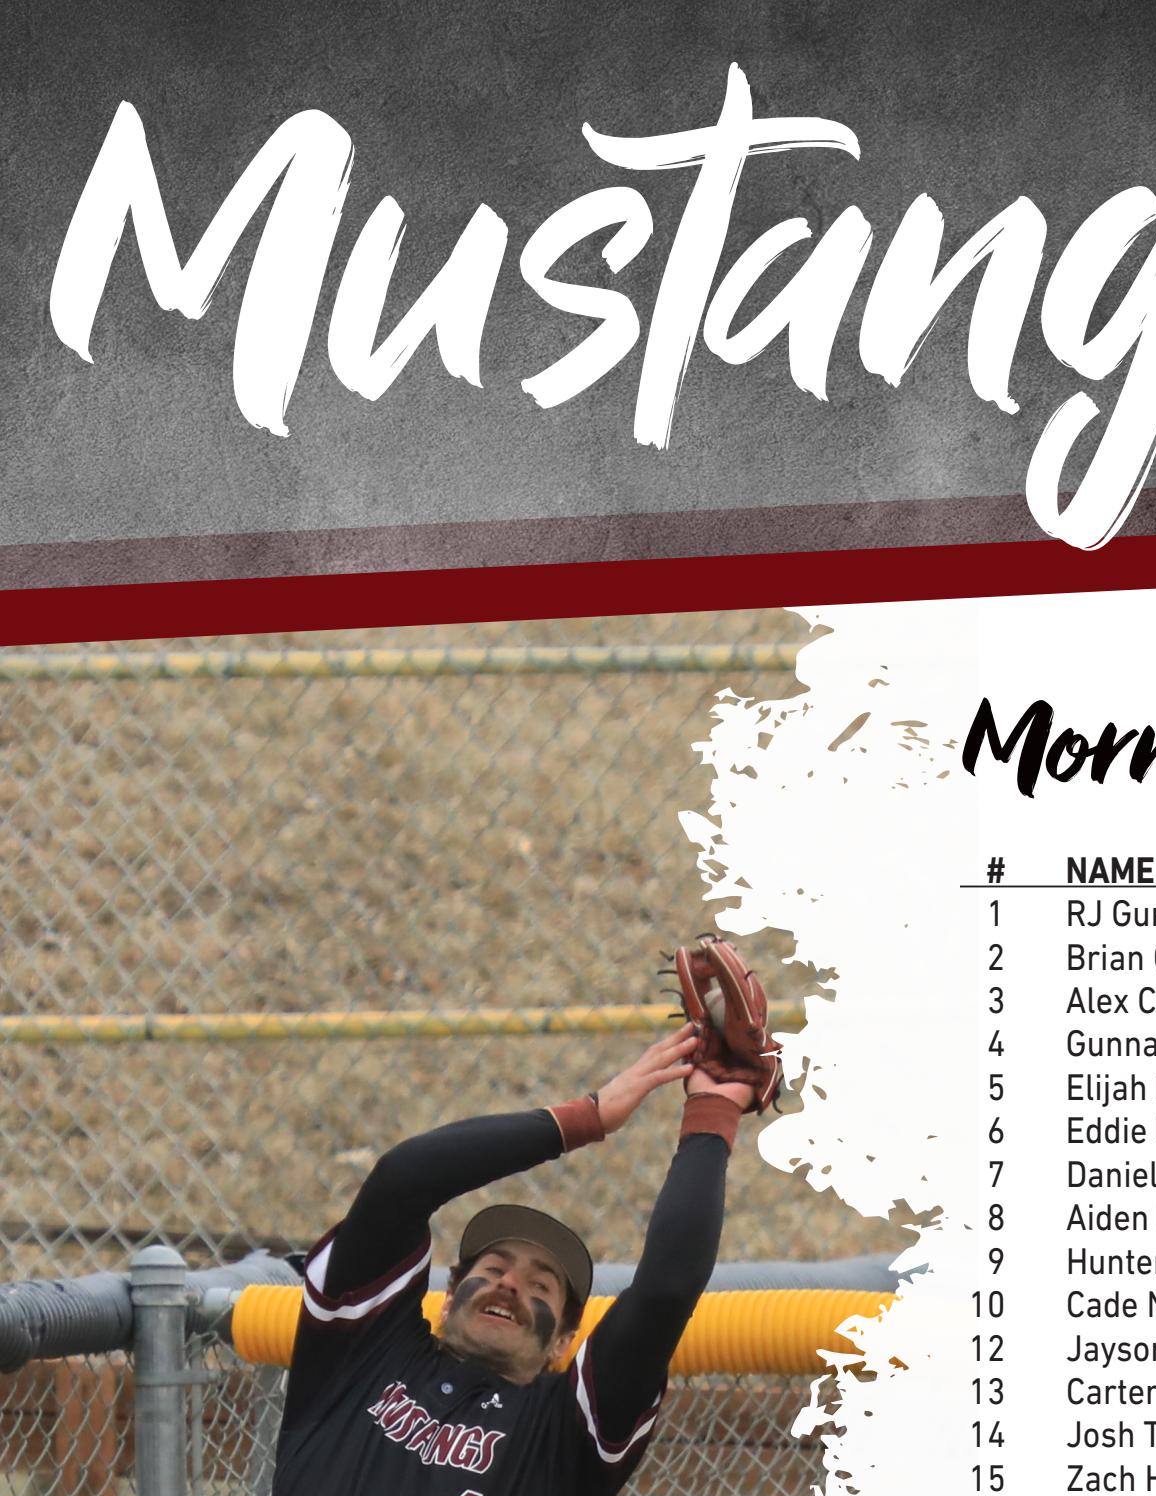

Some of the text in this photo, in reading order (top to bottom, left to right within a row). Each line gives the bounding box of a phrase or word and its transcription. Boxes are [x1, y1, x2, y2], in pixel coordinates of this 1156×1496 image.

[986, 856, 1006, 884] #
[1067, 856, 1154, 884] NAME
[990, 899, 999, 927] 1
[1067, 899, 1101, 927] RJ
[988, 1029, 1005, 1057] 4
[989, 1160, 1004, 1188] 7
[988, 1247, 1004, 1275] 9
[972, 1377, 1004, 1405] 13
